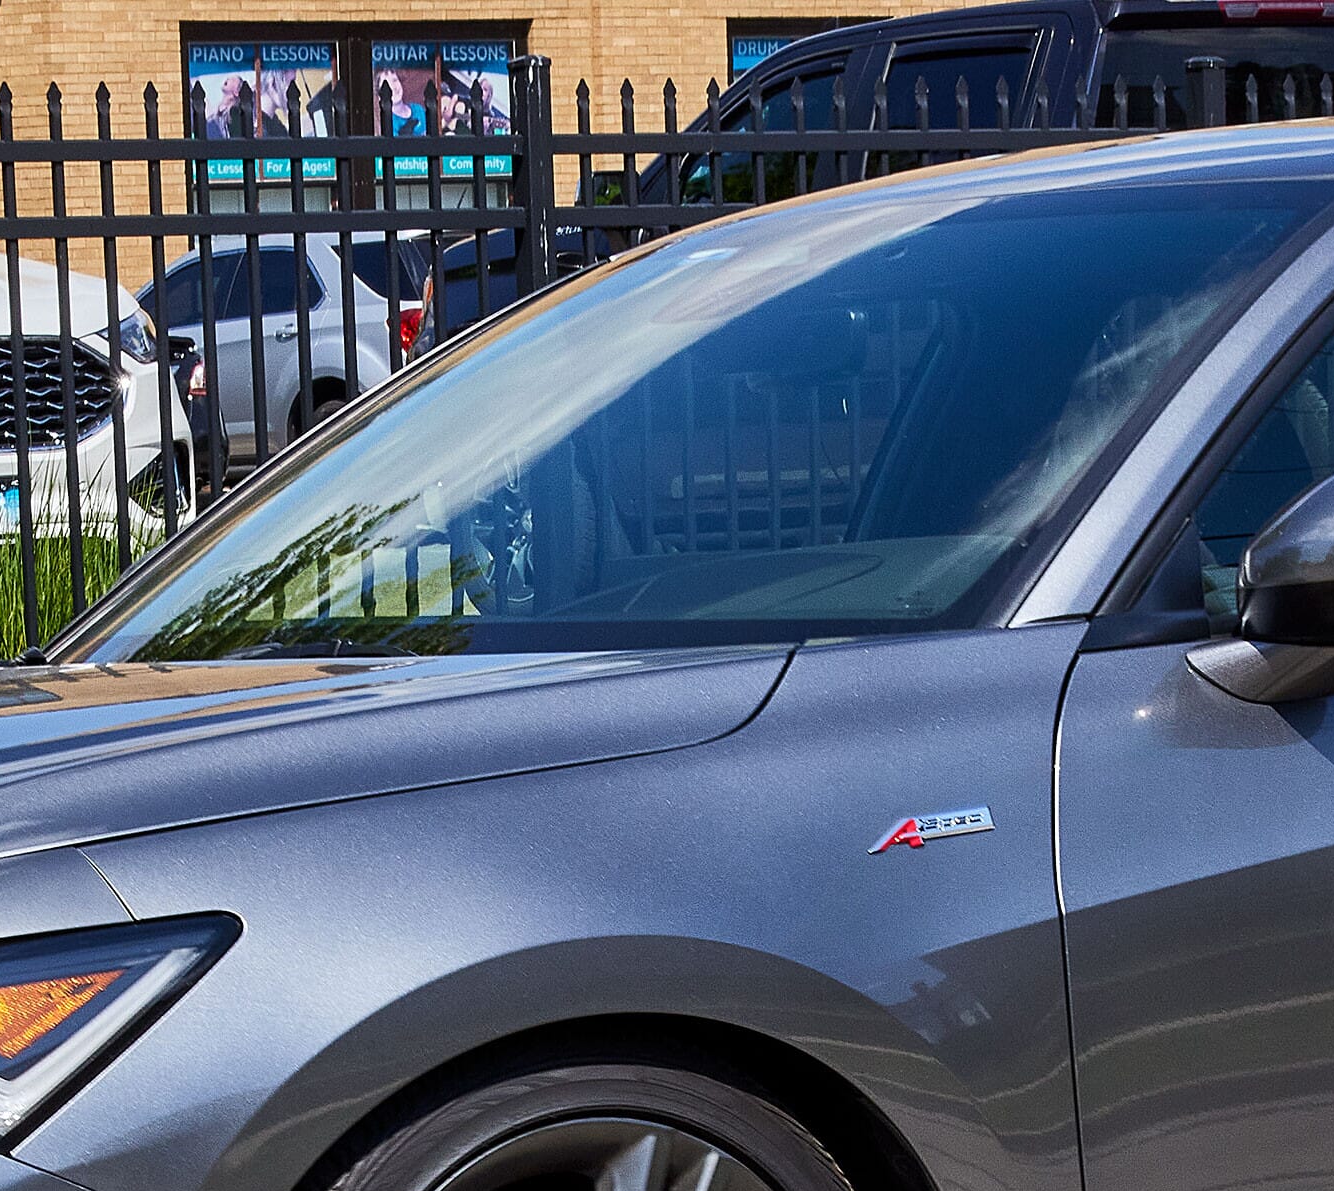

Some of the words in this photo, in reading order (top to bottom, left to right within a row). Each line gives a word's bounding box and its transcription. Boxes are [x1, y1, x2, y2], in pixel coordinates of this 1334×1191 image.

[192, 47, 243, 62] PIANO
[262, 46, 329, 61] LESSONS
[372, 45, 427, 61] GUITAR
[442, 45, 507, 60] LESSONS
[738, 40, 778, 56] DRUM
[267, 161, 283, 173] For
[303, 160, 331, 175] Ages!
[449, 157, 505, 172] Comnity
